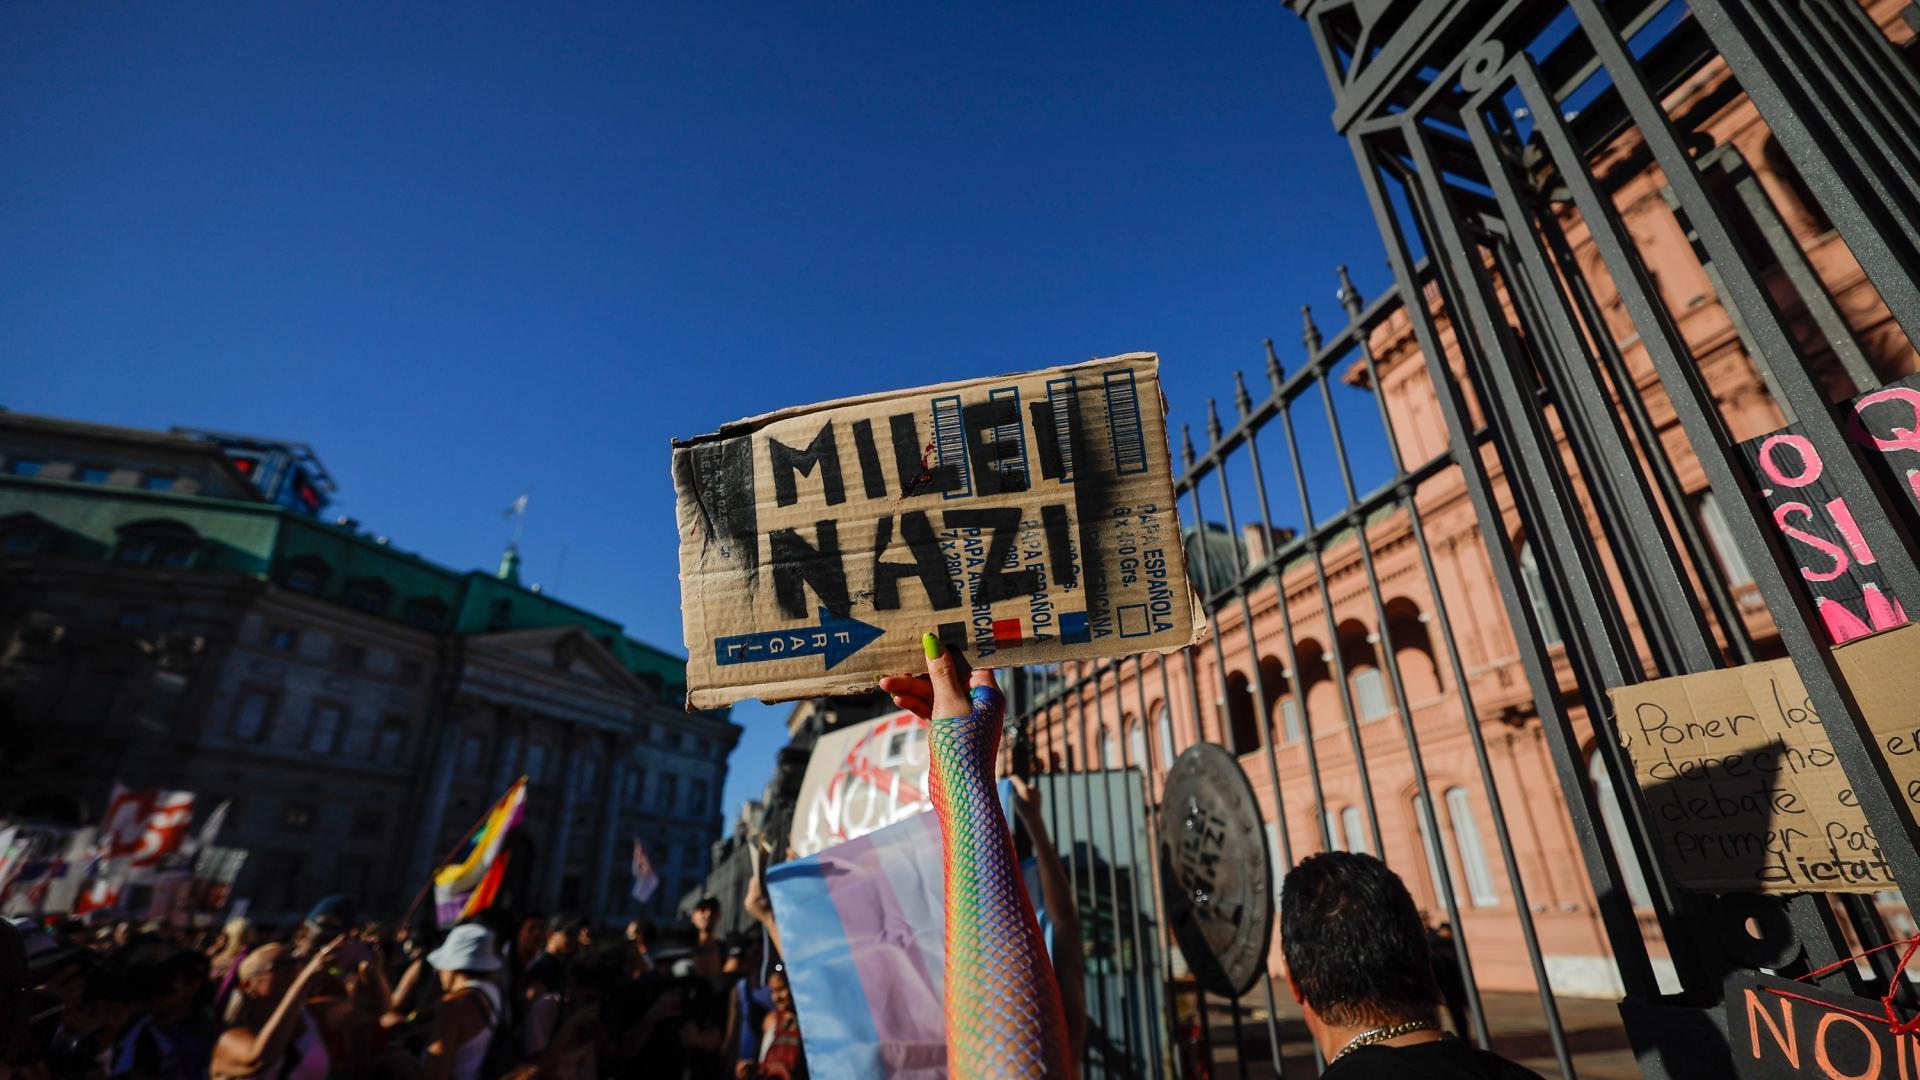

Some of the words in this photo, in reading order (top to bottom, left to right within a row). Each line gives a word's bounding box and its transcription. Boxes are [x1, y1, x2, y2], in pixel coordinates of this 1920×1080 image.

[768, 399, 1070, 508] MILEI
[768, 504, 1071, 619] NAZI
[962, 528, 984, 567] PAPA
[1121, 558, 1139, 587] Grs.
[1143, 548, 1174, 633] ESPAÑOLA
[727, 631, 850, 658] FRAGIL
[1635, 702, 1756, 747] Poner
[1649, 731, 1836, 782] derecho
[1661, 781, 1806, 825] debate
[1673, 824, 1808, 865] primer
[1754, 846, 1895, 885] dictat
